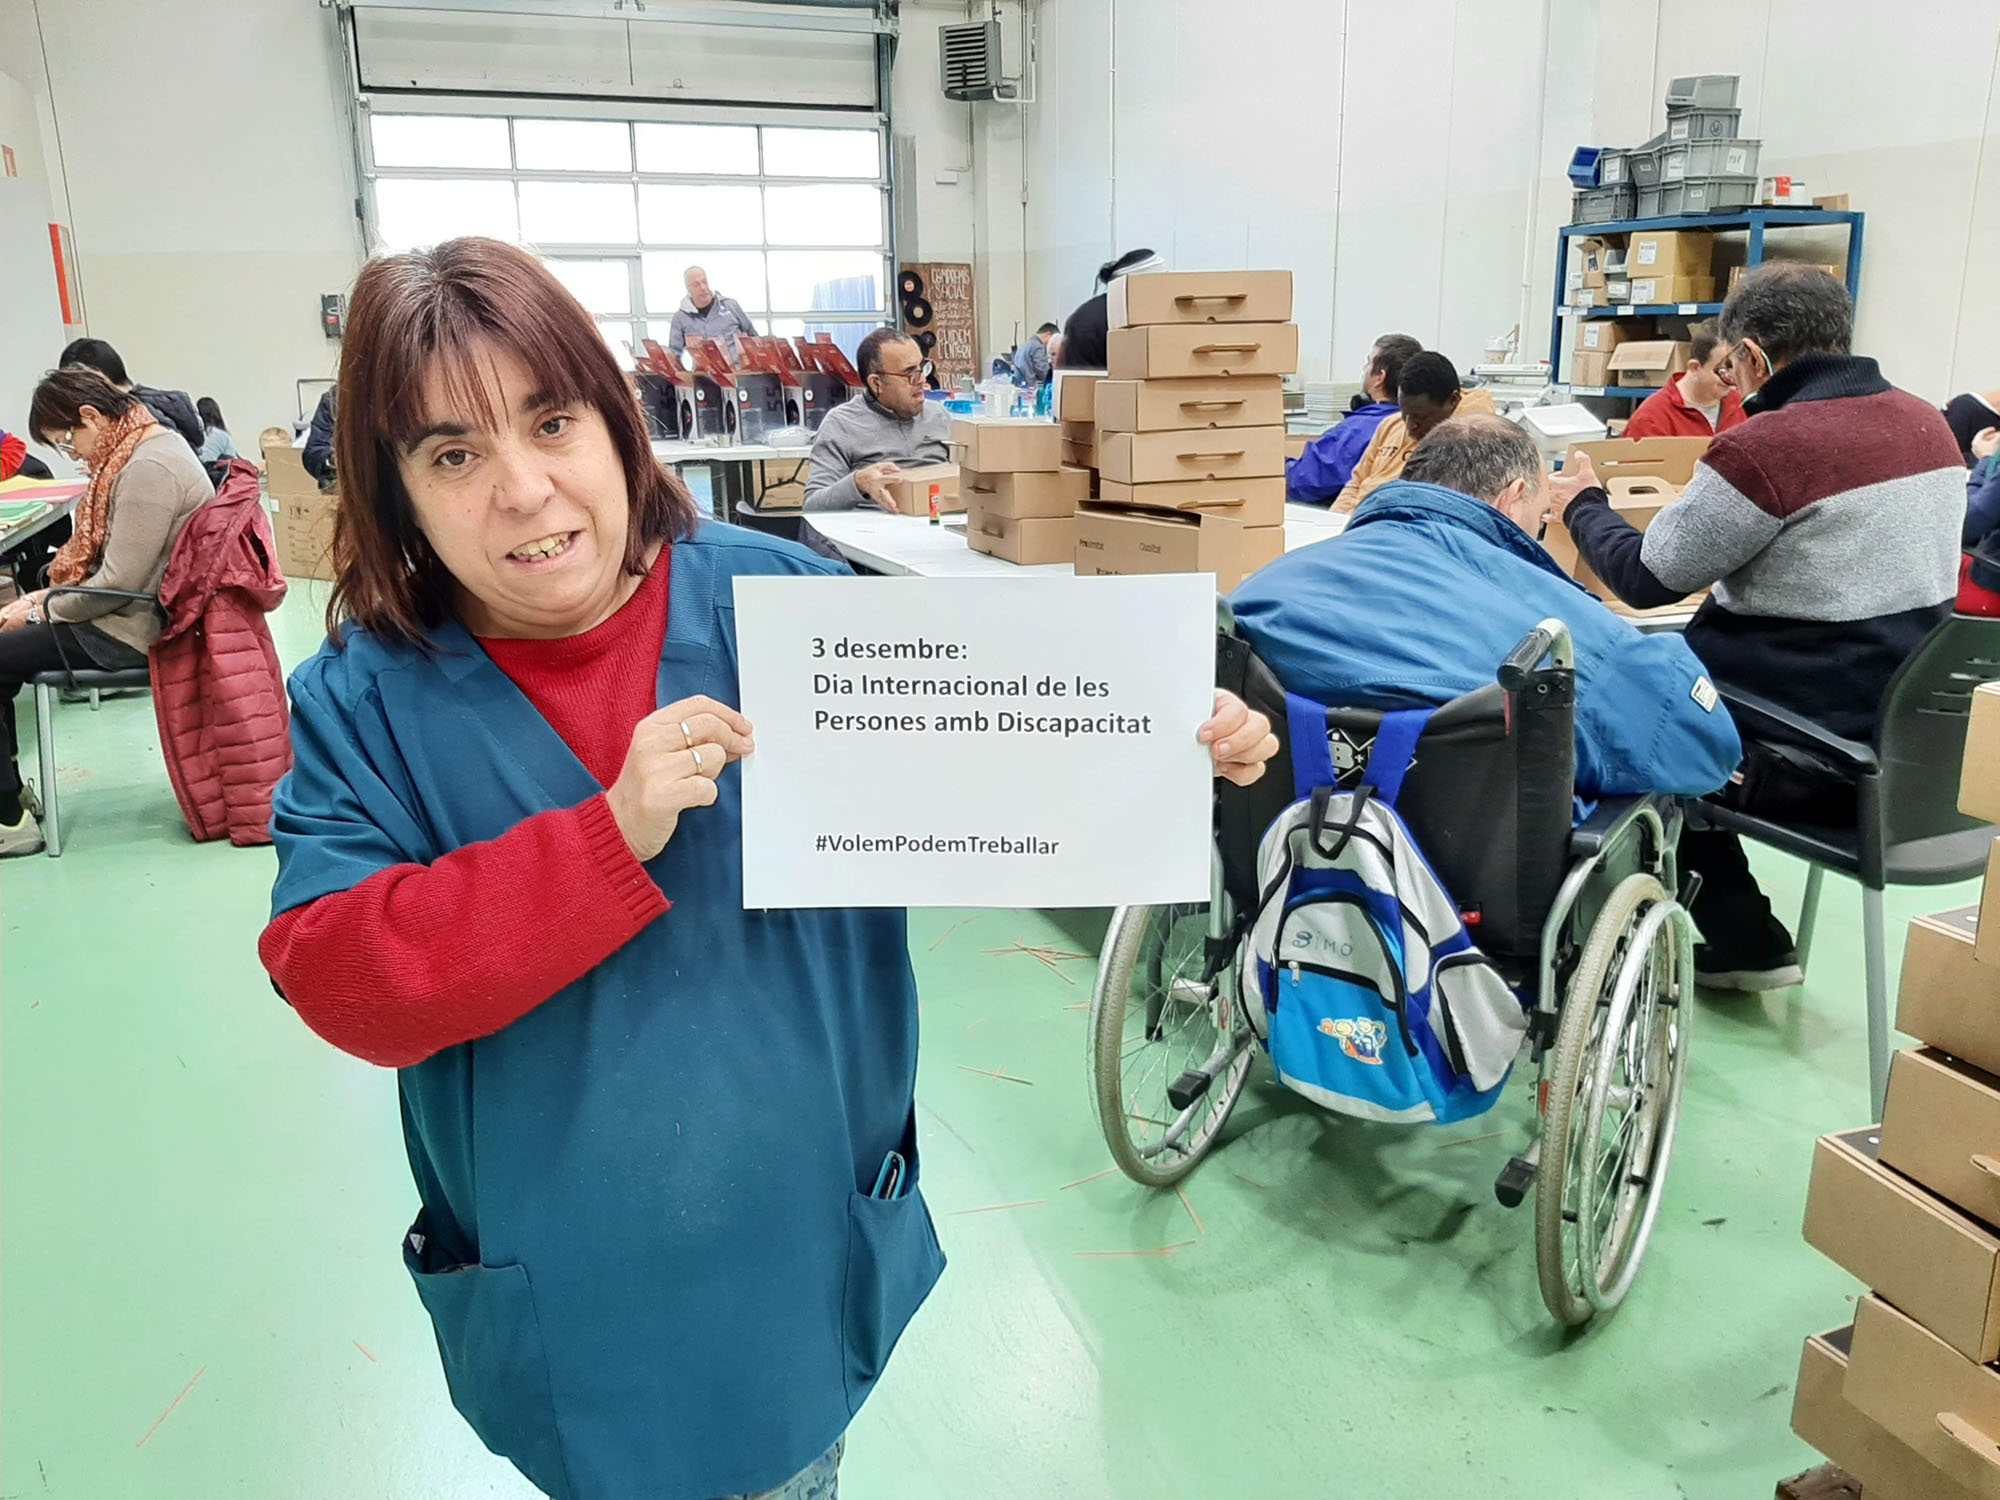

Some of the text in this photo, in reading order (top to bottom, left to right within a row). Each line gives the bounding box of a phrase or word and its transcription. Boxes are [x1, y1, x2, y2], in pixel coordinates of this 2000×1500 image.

[934, 284, 970, 300] SOCIAL
[811, 637, 968, 660] 3 desembre:
[813, 674, 1110, 698] Dia Internacional de les
[814, 711, 1152, 738] Persones amb Discapacitat
[815, 835, 1060, 856] #VolemPodemTreballar
